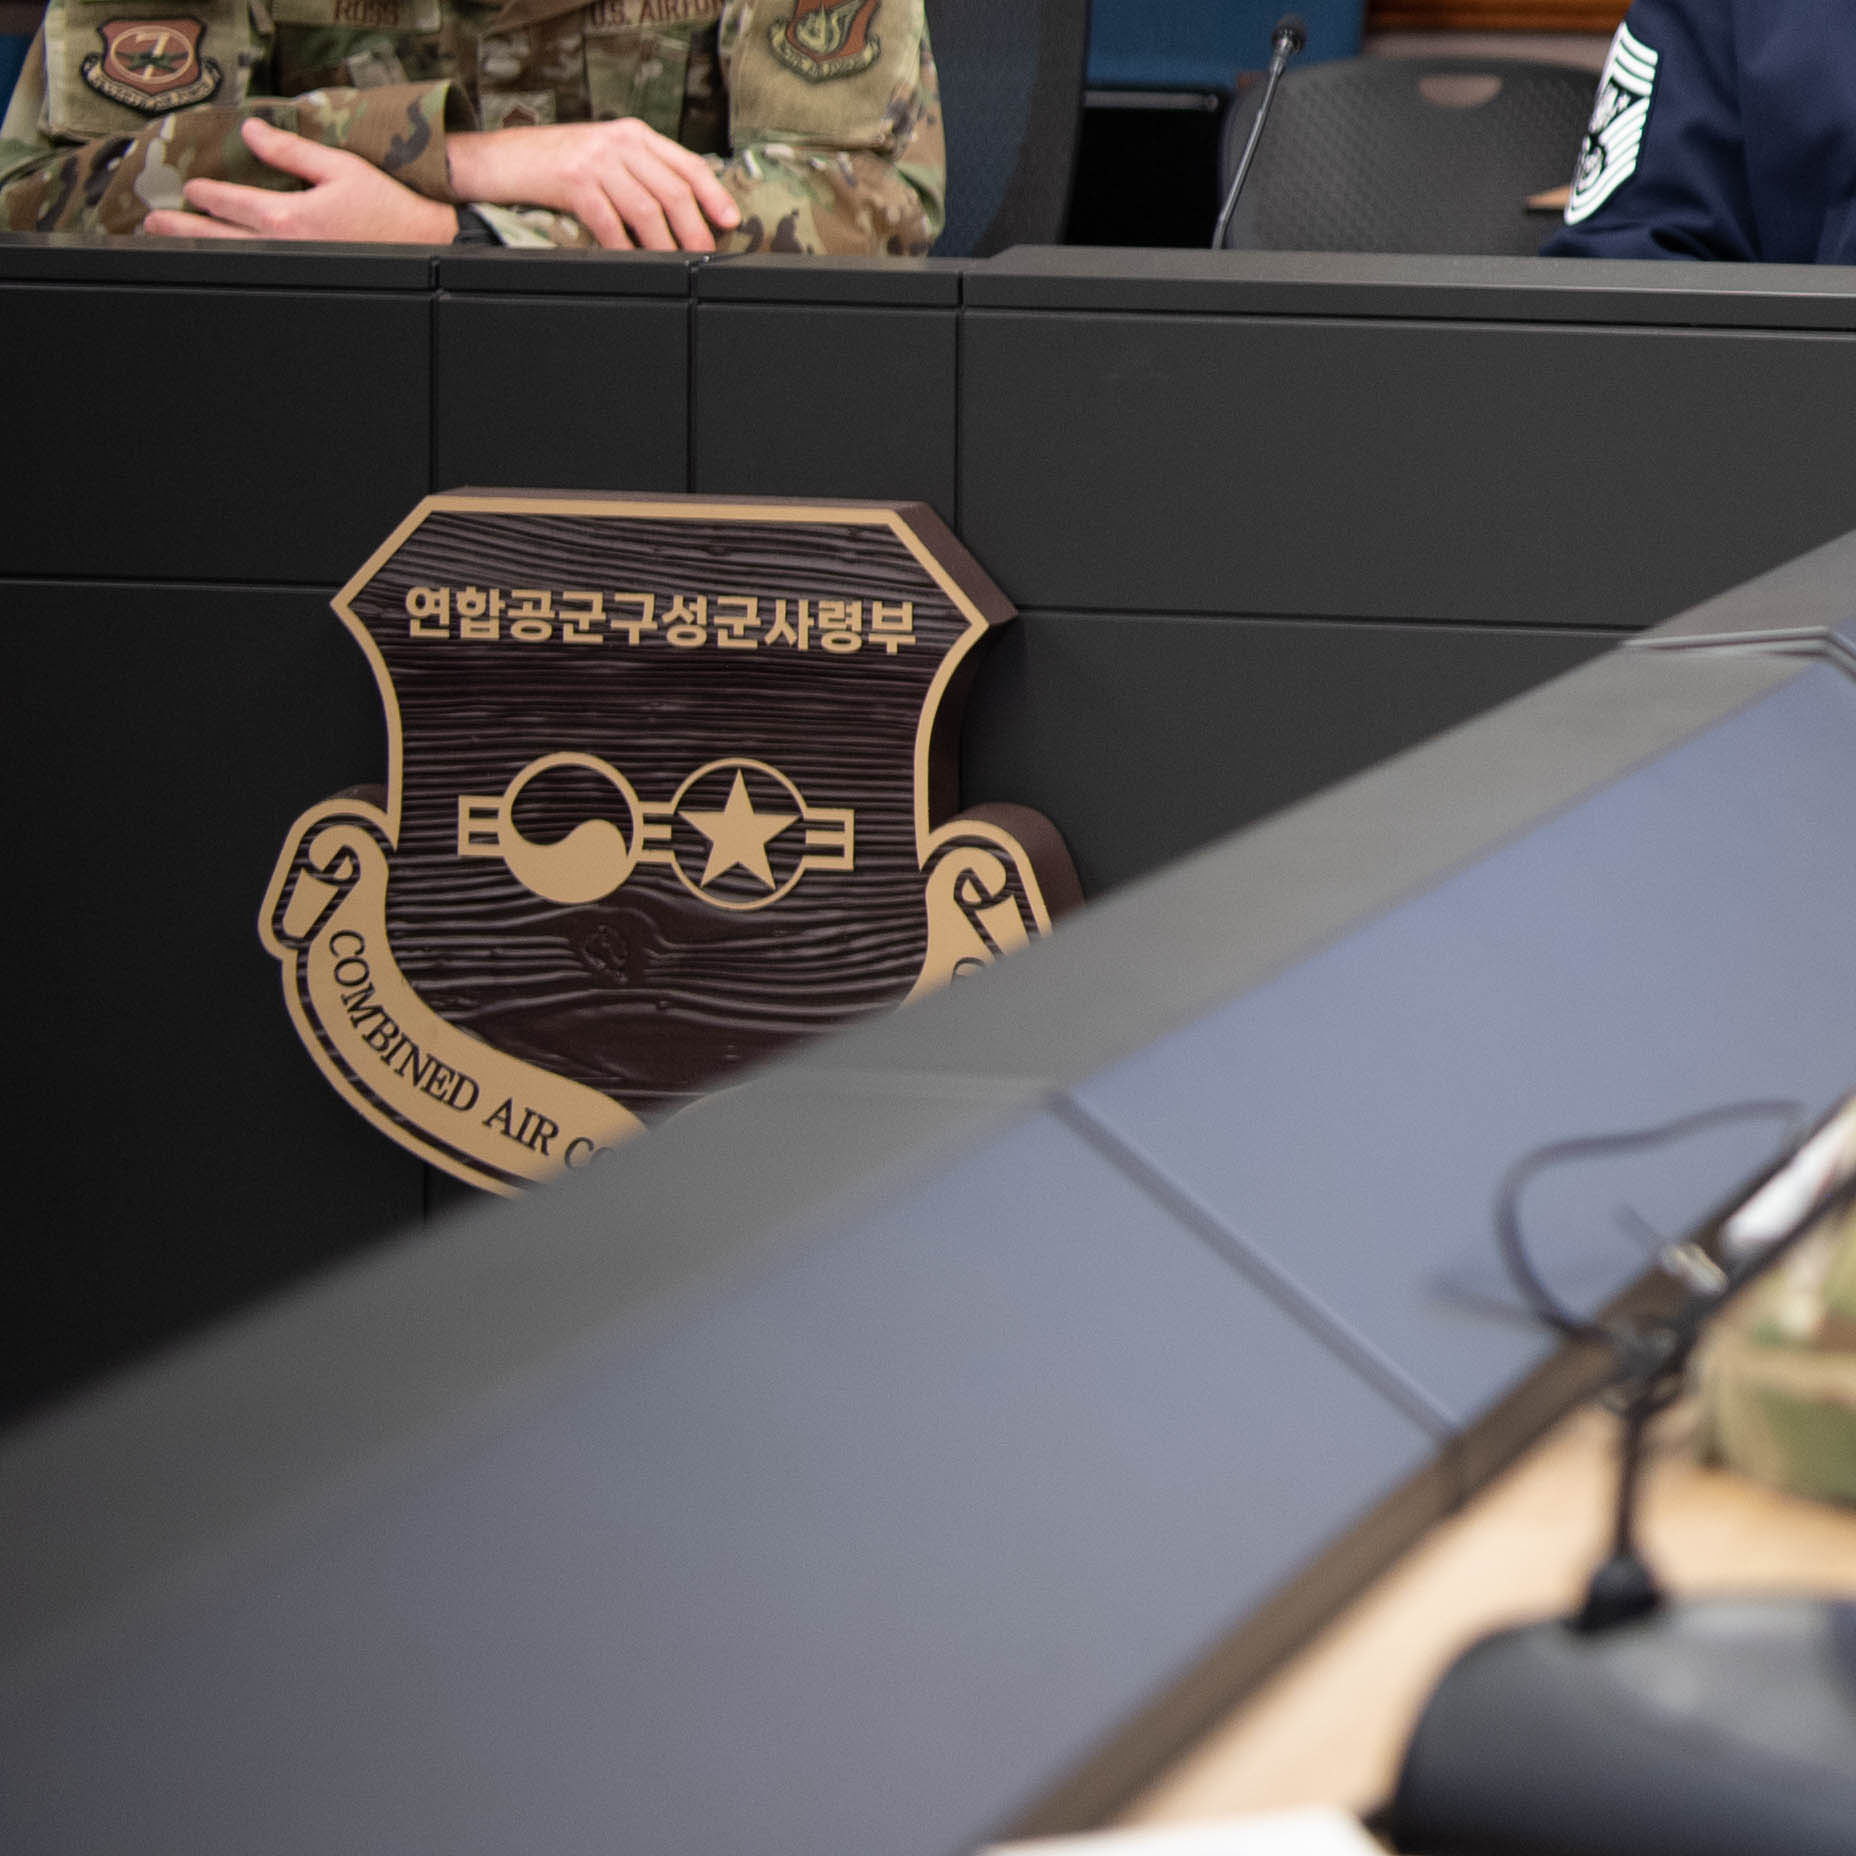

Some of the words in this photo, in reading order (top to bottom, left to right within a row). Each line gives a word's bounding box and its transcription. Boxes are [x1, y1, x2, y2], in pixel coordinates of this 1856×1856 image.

[404, 585, 917, 655] 연합공군구성군사령부
[328, 929, 480, 1112] COMBINED
[482, 1097, 560, 1156] AIR
